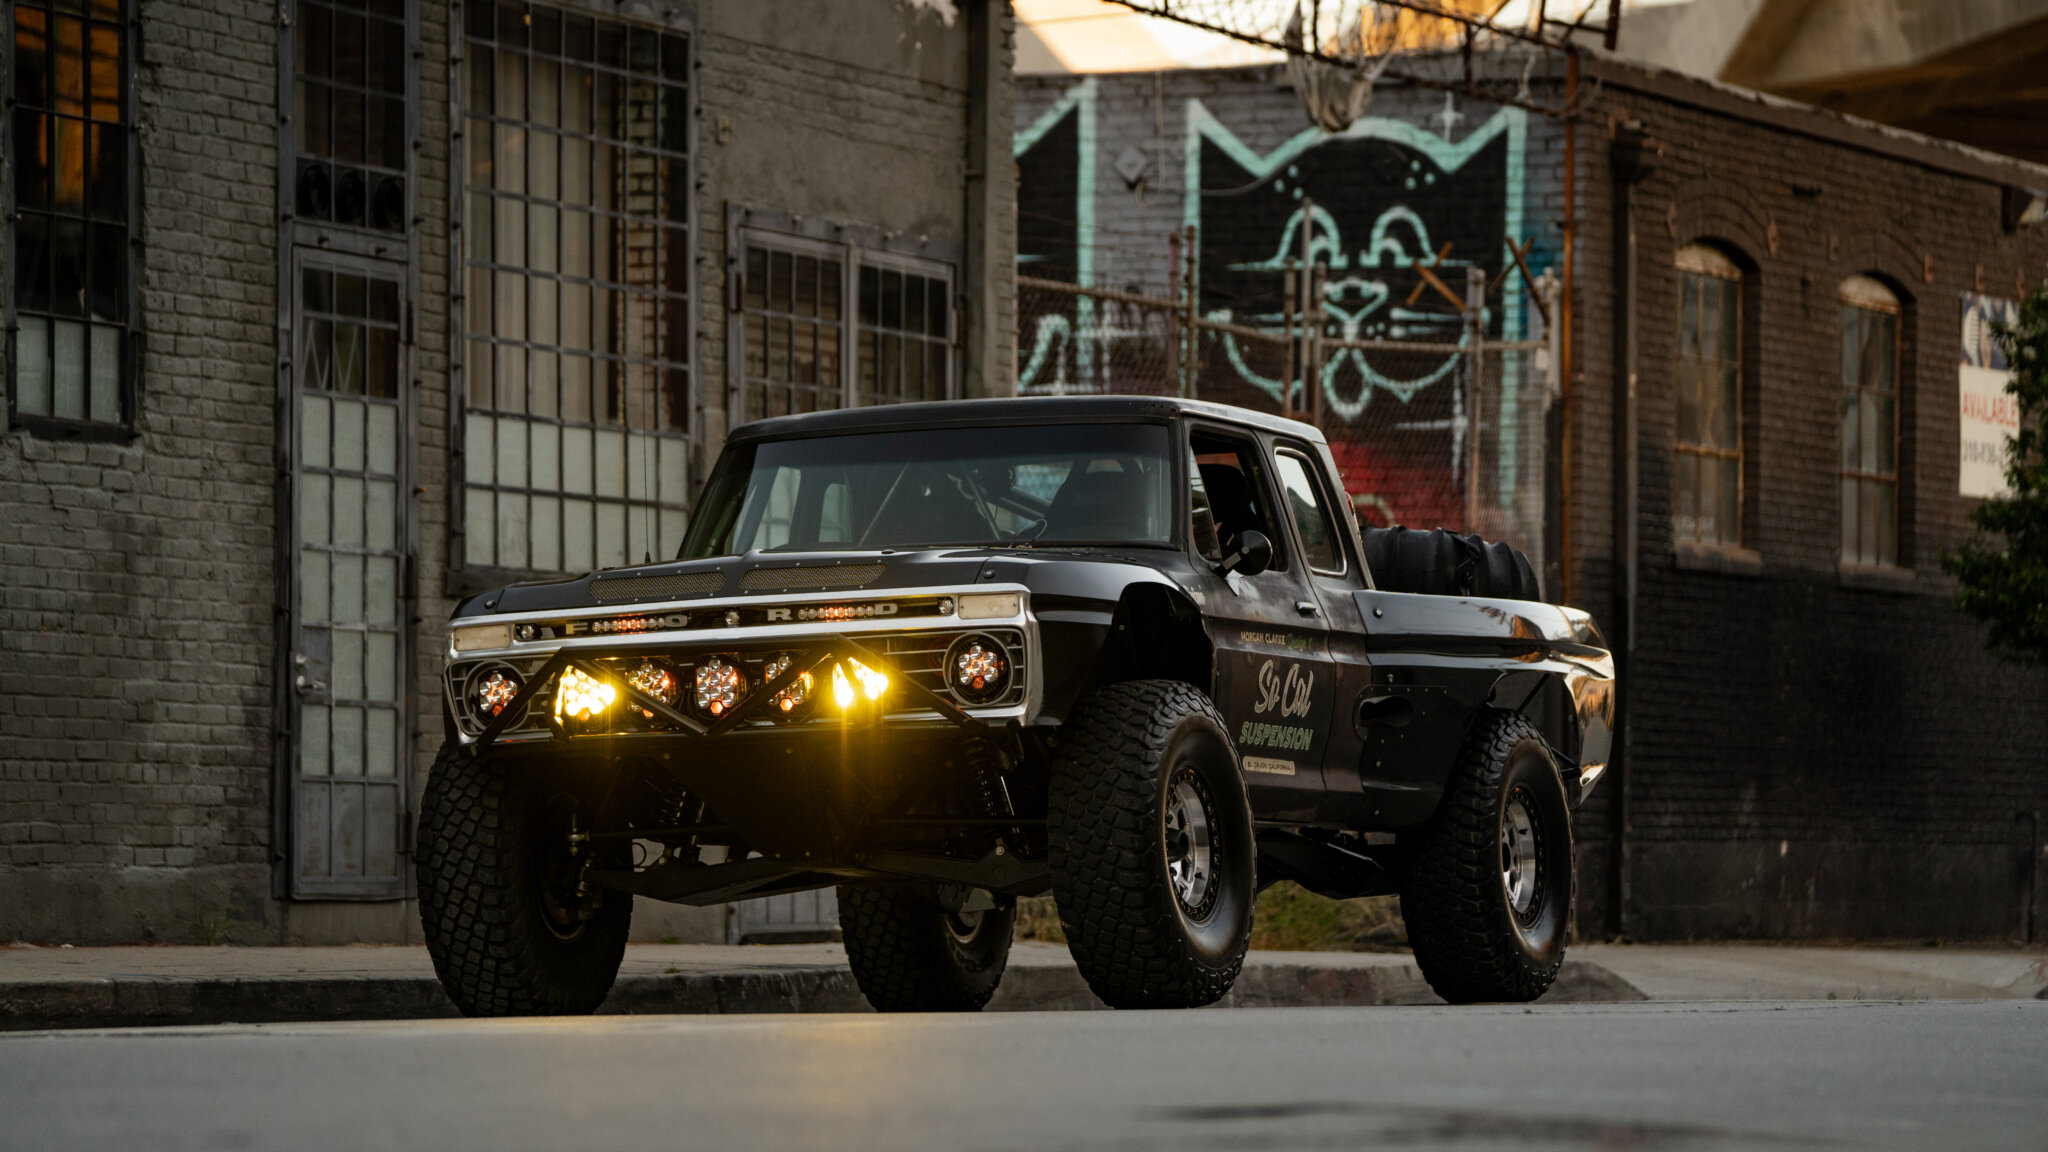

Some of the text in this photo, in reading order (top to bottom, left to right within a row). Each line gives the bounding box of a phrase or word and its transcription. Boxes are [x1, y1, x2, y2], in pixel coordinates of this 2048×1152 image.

[1962, 391, 2017, 428] AVAILABLE
[1240, 631, 1264, 644] MORGAN
[1265, 633, 1286, 646] CLARKE
[1254, 659, 1314, 718] So Cal
[1239, 721, 1314, 751] SUSPENSION
